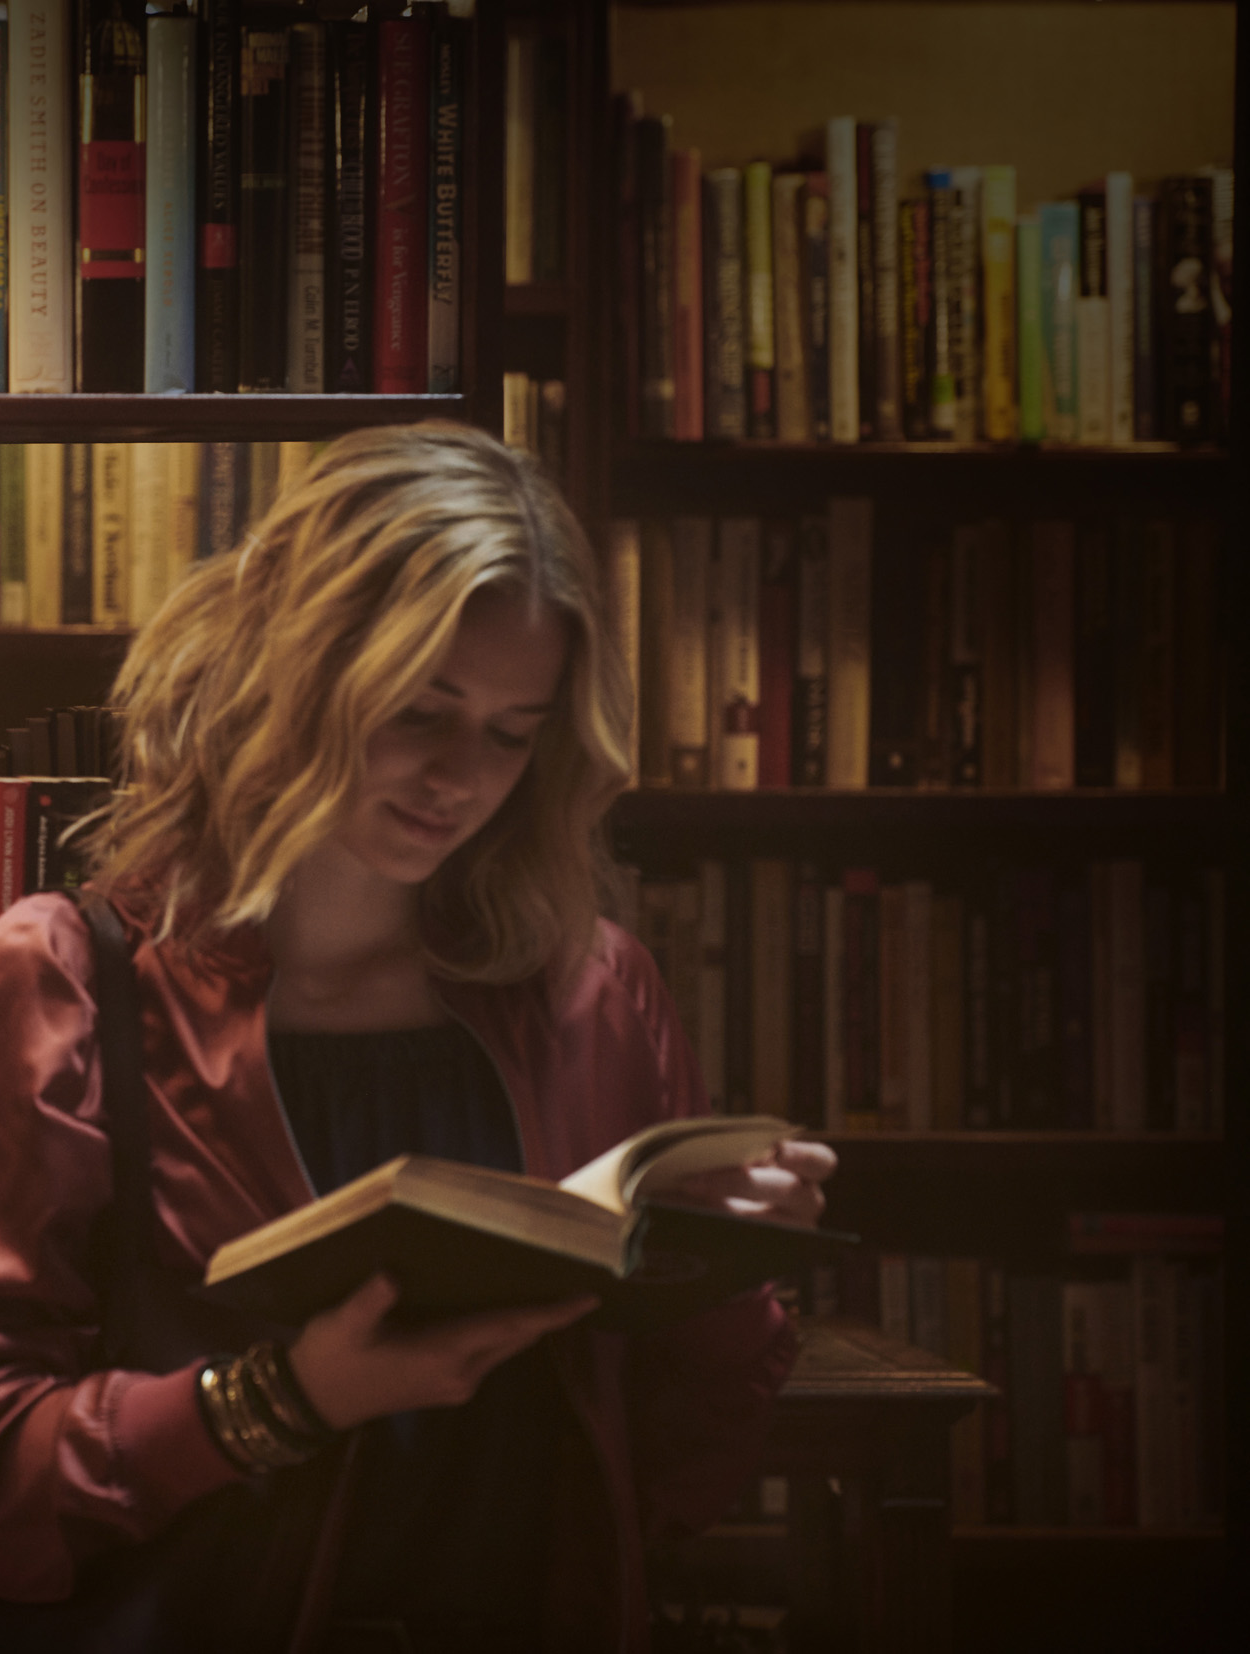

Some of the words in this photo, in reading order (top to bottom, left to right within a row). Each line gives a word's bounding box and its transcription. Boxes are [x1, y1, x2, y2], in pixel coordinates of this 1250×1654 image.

[30, 12, 48, 86] ZADIE
[391, 33, 413, 75] SUE
[212, 33, 231, 145] ENDANGERED
[30, 96, 47, 173] SMITH
[390, 79, 415, 186] GRAFTON
[435, 103, 459, 177] WHITE
[29, 183, 48, 214] ON
[211, 150, 231, 211] VALUES
[30, 225, 49, 318] BEAUTY
[391, 244, 408, 269] for
[392, 228, 407, 242] is
[433, 184, 460, 304] BUTTERFLY
[388, 271, 407, 353] Vengeance
[303, 338, 321, 386] Turnbull
[3, 829, 14, 856] LYNN
